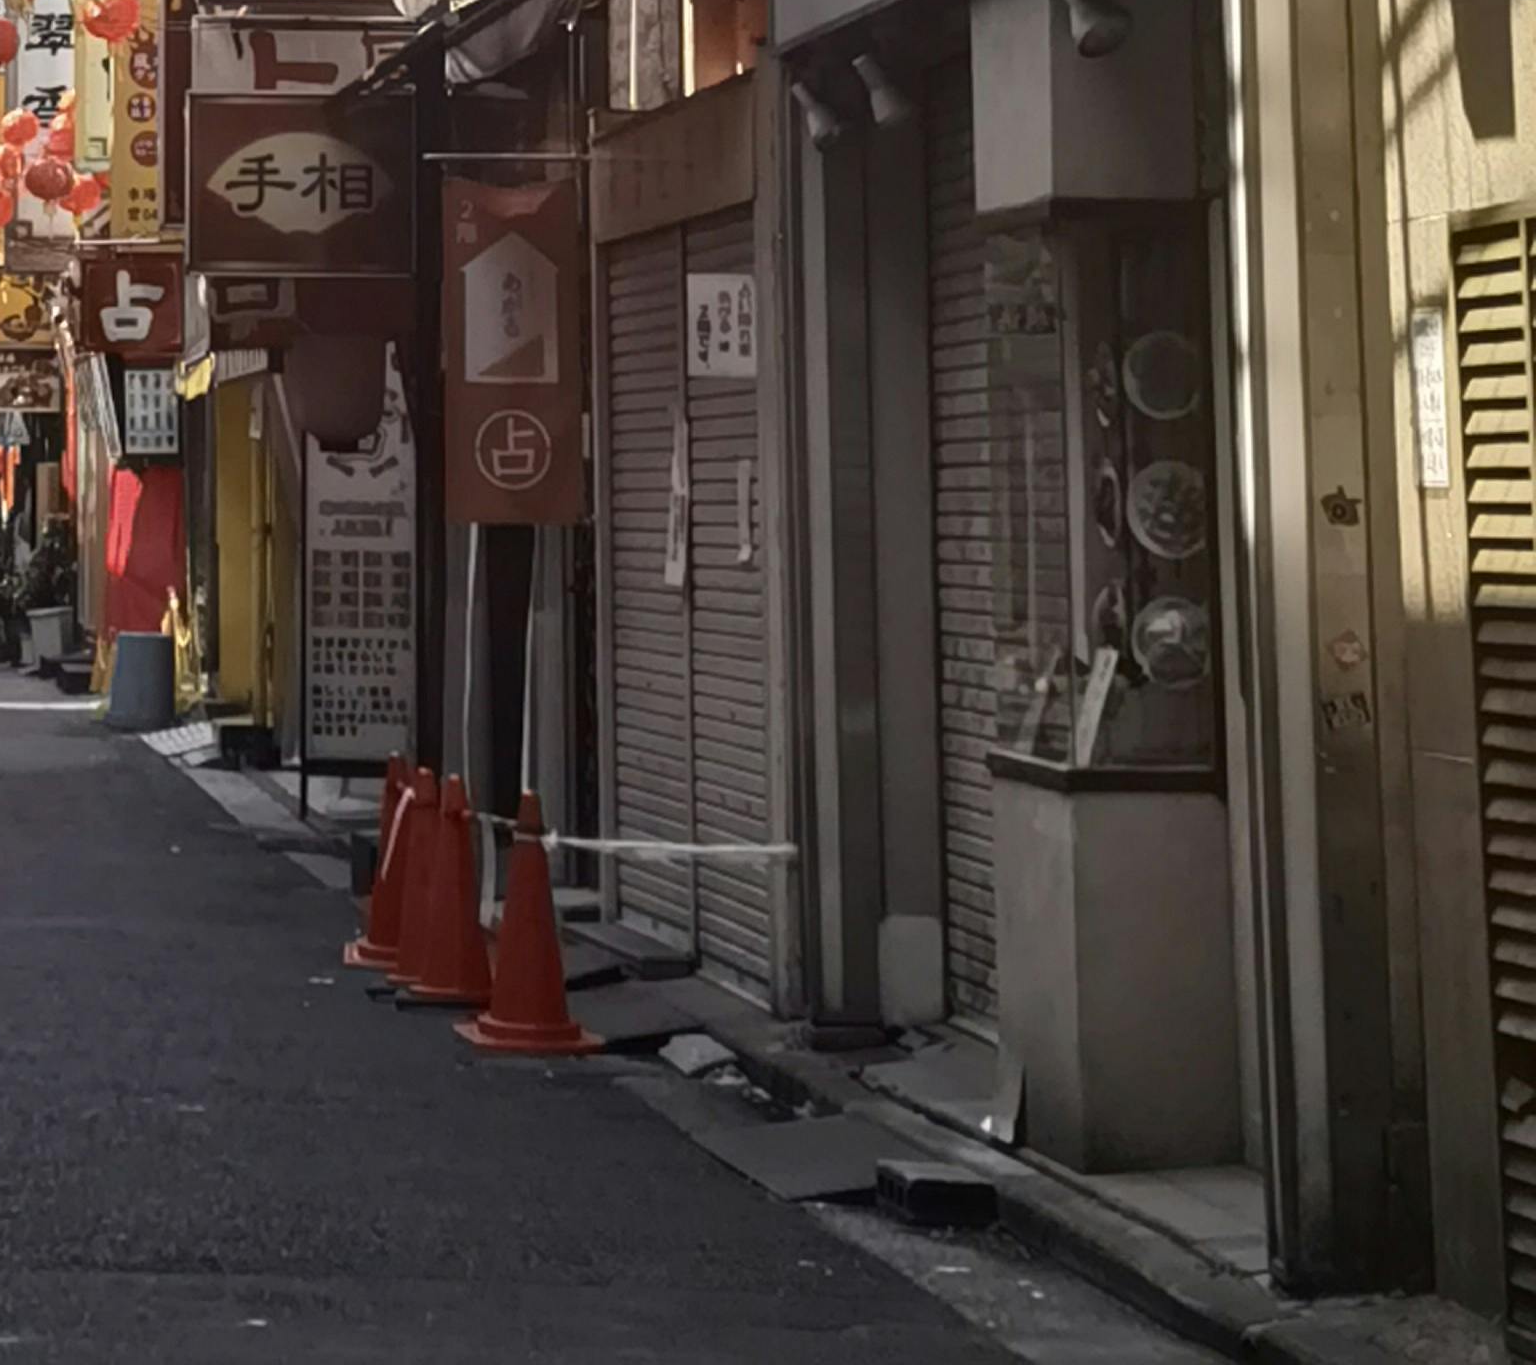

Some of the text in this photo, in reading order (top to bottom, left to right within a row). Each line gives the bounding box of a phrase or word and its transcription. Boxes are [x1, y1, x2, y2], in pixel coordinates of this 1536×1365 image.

[225, 153, 373, 213] 手相
[98, 269, 164, 343] 占
[491, 416, 535, 477] 占
